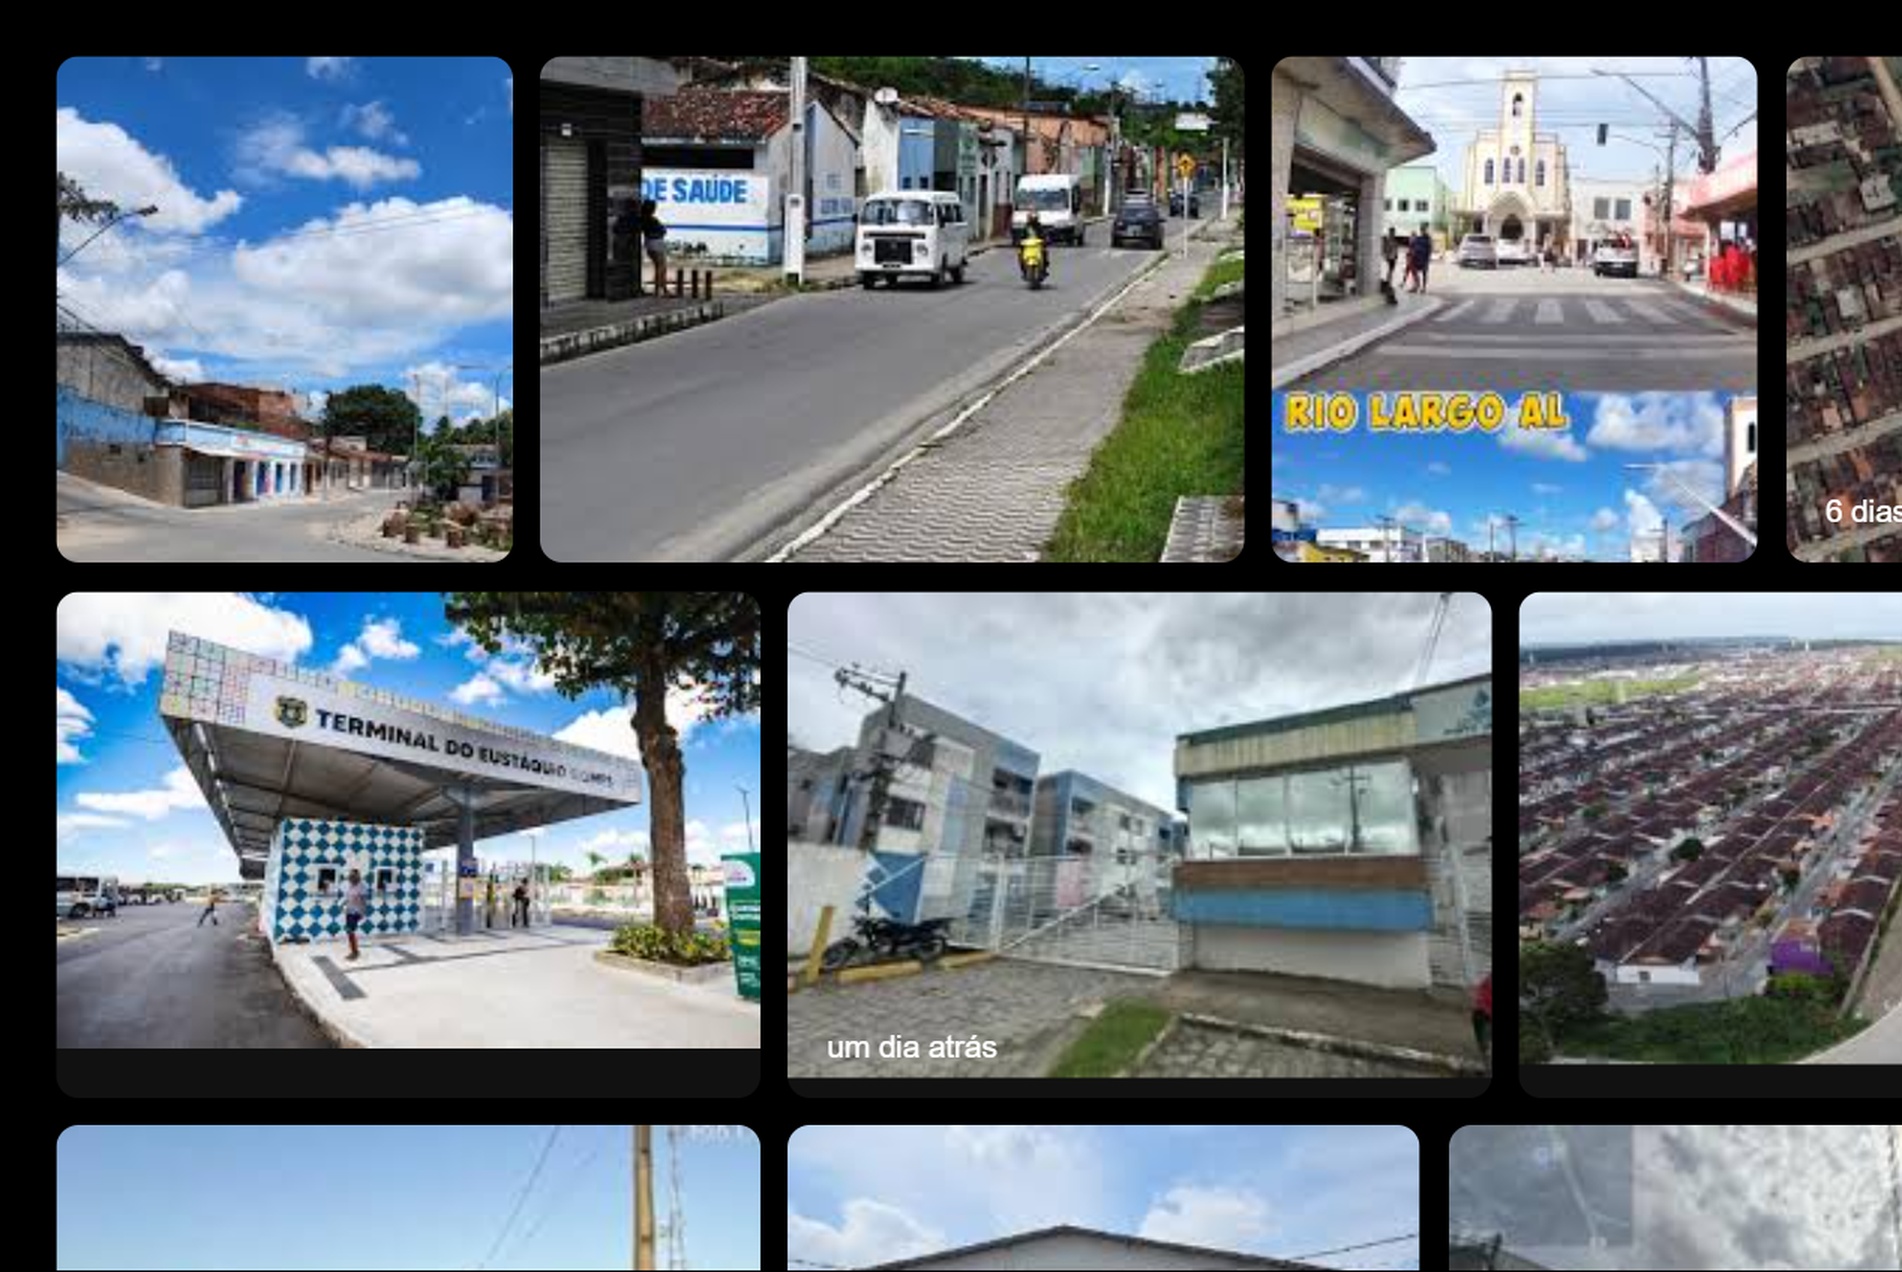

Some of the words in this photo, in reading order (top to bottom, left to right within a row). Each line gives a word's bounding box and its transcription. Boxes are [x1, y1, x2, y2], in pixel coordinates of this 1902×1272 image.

[672, 173, 747, 203] SAÚDE
[316, 709, 440, 752] TERMINAL
[445, 739, 474, 758] DO
